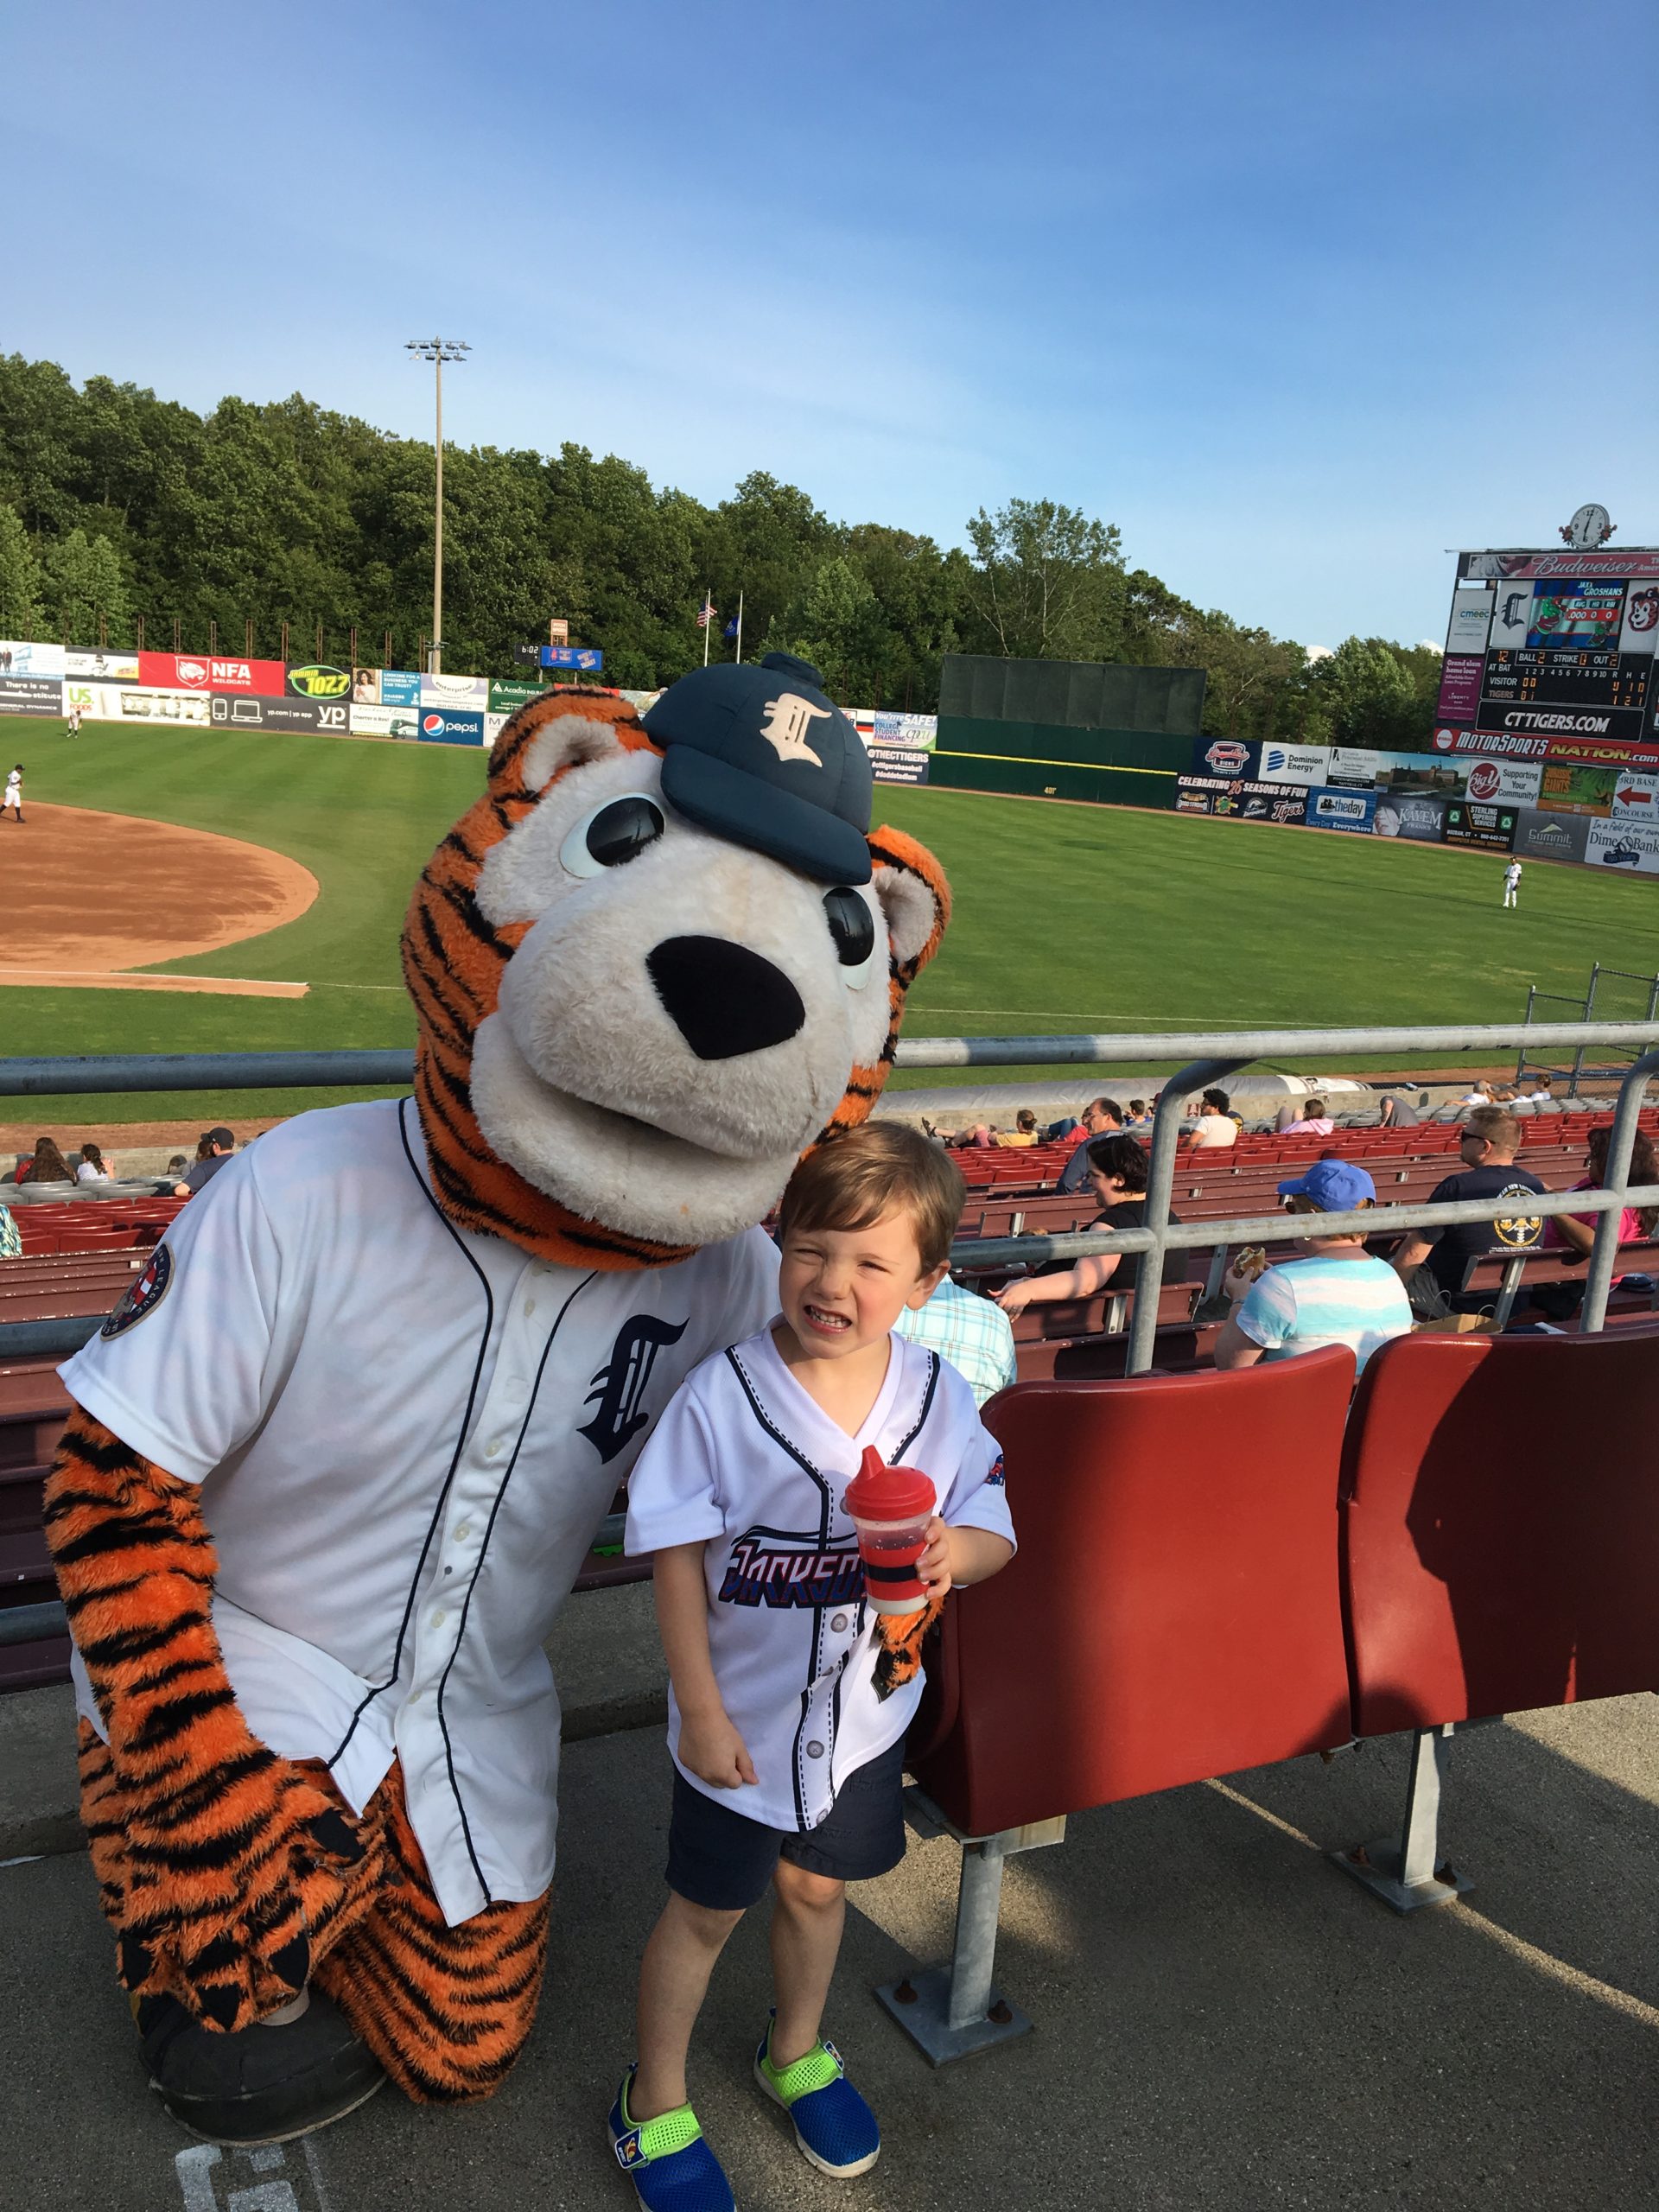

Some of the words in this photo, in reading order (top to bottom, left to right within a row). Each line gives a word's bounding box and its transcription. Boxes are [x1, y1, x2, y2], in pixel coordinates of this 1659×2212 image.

[1531, 556, 1637, 575] Budweiser
[1583, 588, 1623, 596] GROSHANS
[1460, 610, 1490, 619] cmeec
[1519, 653, 1536, 662] BALL
[1553, 654, 1579, 664] STRIKE
[1593, 655, 1609, 664] OUT
[212, 662, 251, 678] NFA
[1488, 663, 1497, 671] AT
[1498, 664, 1511, 672] BAT
[5, 681, 28, 690] There
[306, 675, 349, 695] 107.7
[435, 681, 473, 693] enterprise
[1490, 677, 1518, 686] VISITOR
[504, 686, 526, 695] Acadia
[1489, 690, 1515, 699] TIGERS
[318, 705, 346, 726] yp
[903, 714, 937, 726] SAFE!
[446, 722, 479, 734] pepsi
[1504, 711, 1611, 733] CTTIGERS.COM
[867, 748, 929, 763] @THECTTIGERS
[1288, 755, 1324, 765] Dominion
[1287, 763, 1314, 772] Energy
[1503, 768, 1538, 782] Supporting
[1178, 776, 1230, 790] CELEBRATING
[1243, 782, 1280, 796] SEASONS
[1280, 785, 1292, 796] OF
[1291, 787, 1308, 798] FUN
[1512, 780, 1527, 790] Your
[1543, 778, 1571, 793] GIANTS
[1637, 779, 1658, 787] BASE
[1497, 788, 1537, 802] Community!
[1271, 800, 1306, 823] Tigers
[1471, 805, 1498, 816] STERLING
[1612, 806, 1655, 818] CONCOURSE
[1398, 808, 1443, 830] KAYEM
[1471, 813, 1497, 822] SUPERIOR
[1474, 819, 1497, 828] SERVICES
[1332, 822, 1371, 832] Everywhere
[1589, 831, 1618, 847] Dime
[1632, 836, 1659, 853] Bank
[719, 1540, 867, 1608] JACKSO
